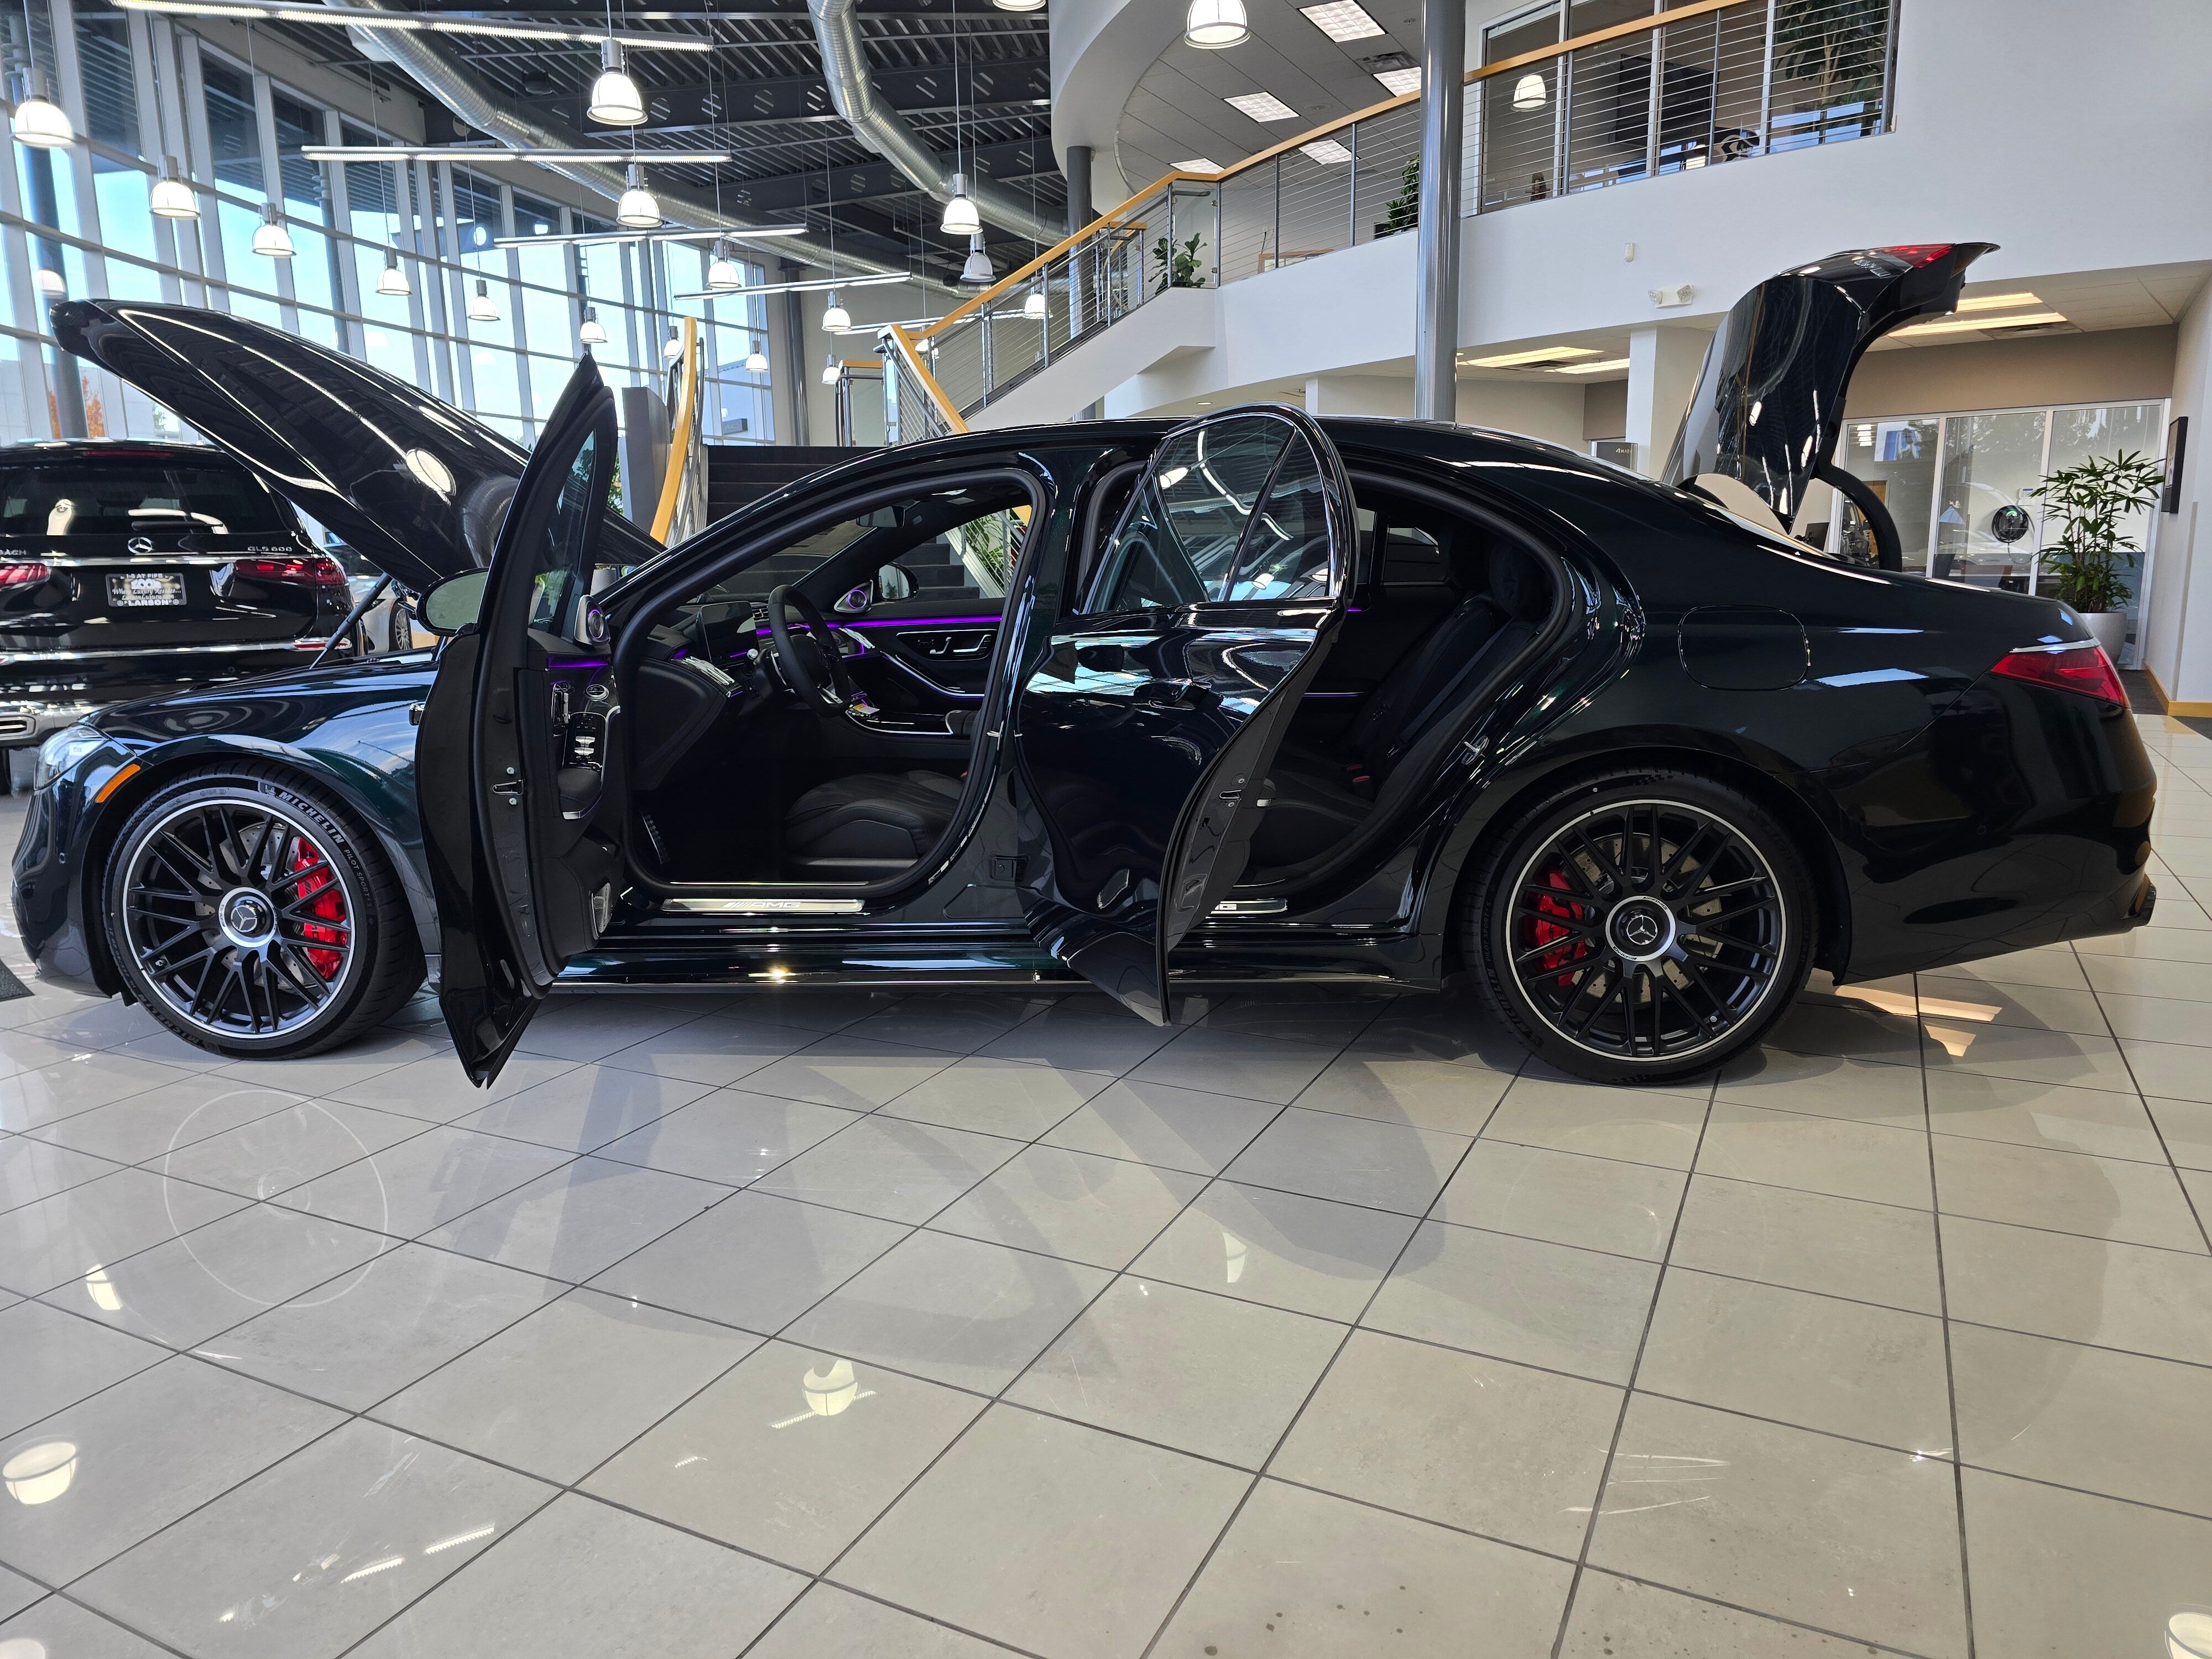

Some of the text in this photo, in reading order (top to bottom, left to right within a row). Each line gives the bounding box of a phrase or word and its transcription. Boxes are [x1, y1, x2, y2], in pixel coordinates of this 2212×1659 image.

[278, 791, 345, 844] MICHELIN
[343, 849, 359, 869] PILOT
[1650, 899, 1668, 911] AMG
[138, 994, 199, 1044] MICHELIN
[1486, 968, 1531, 1034] MICHELIN
